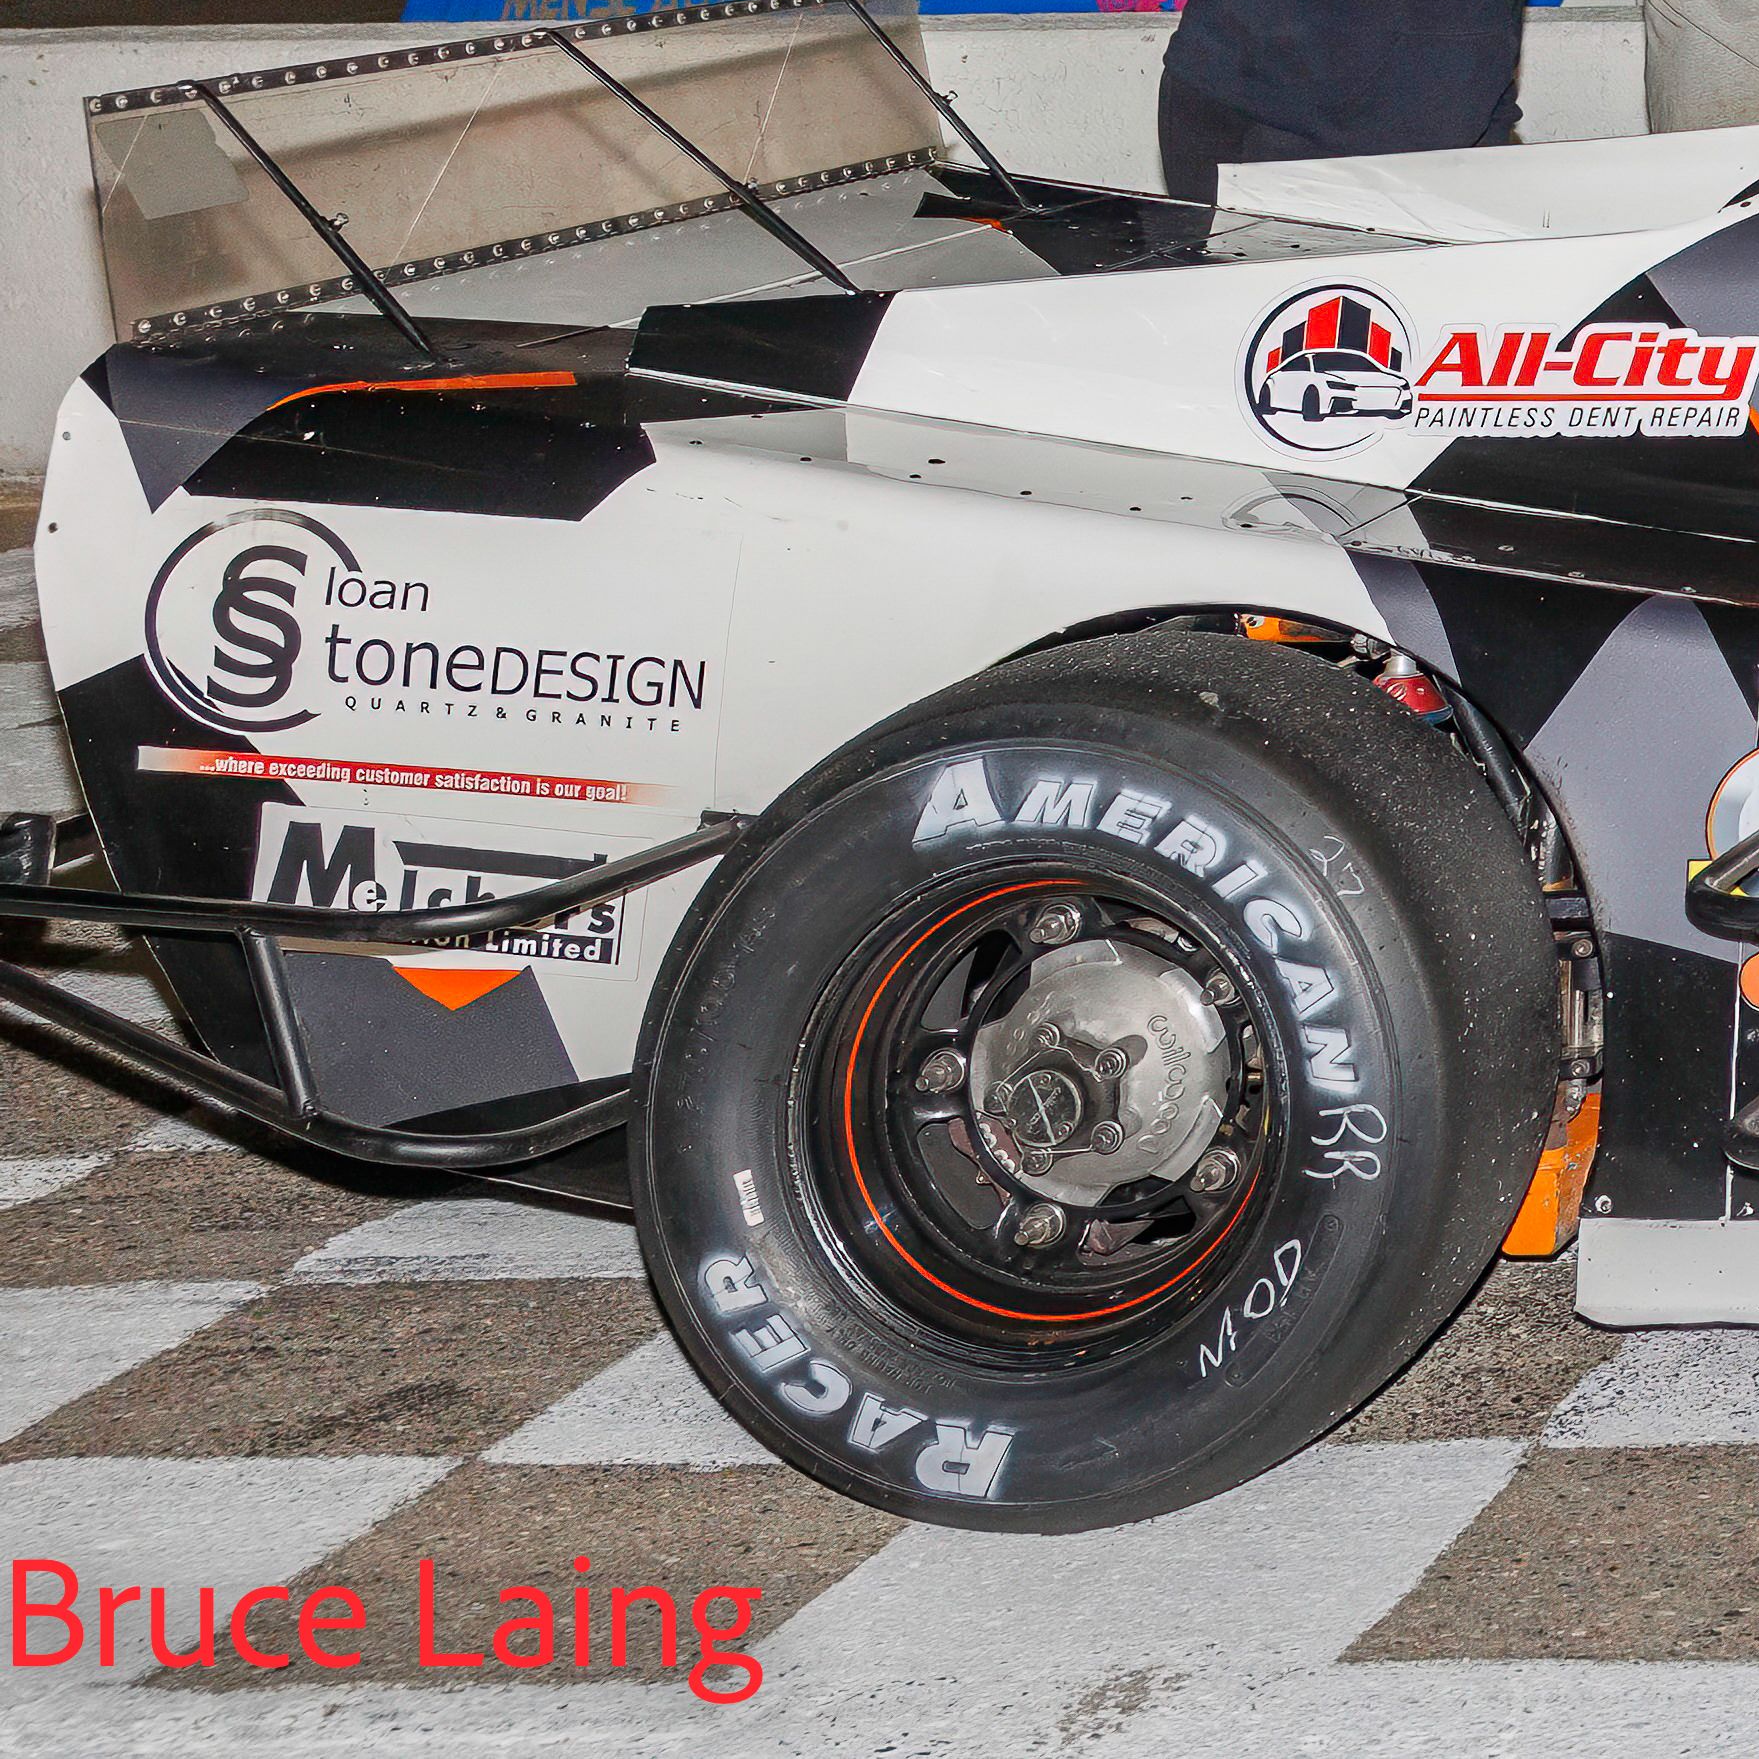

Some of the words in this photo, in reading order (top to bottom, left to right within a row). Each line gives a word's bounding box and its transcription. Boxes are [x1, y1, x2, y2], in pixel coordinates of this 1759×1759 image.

[1414, 331, 1757, 400] All-City
[1414, 406, 1555, 429] PAINTLESS
[1568, 405, 1639, 429] DENT
[1649, 405, 1742, 429] REPAIR
[344, 696, 480, 718] QUARTZ
[525, 708, 682, 733] GRANITE
[269, 760, 351, 784] exceeding
[356, 765, 430, 787] customer
[435, 770, 531, 795] satisfaction
[536, 776, 550, 796] is
[555, 782, 581, 798] our
[586, 781, 627, 802] goal!
[913, 756, 1360, 1086] AMERICAN
[487, 928, 603, 963] Limited
[702, 1253, 1015, 1500] RACER
